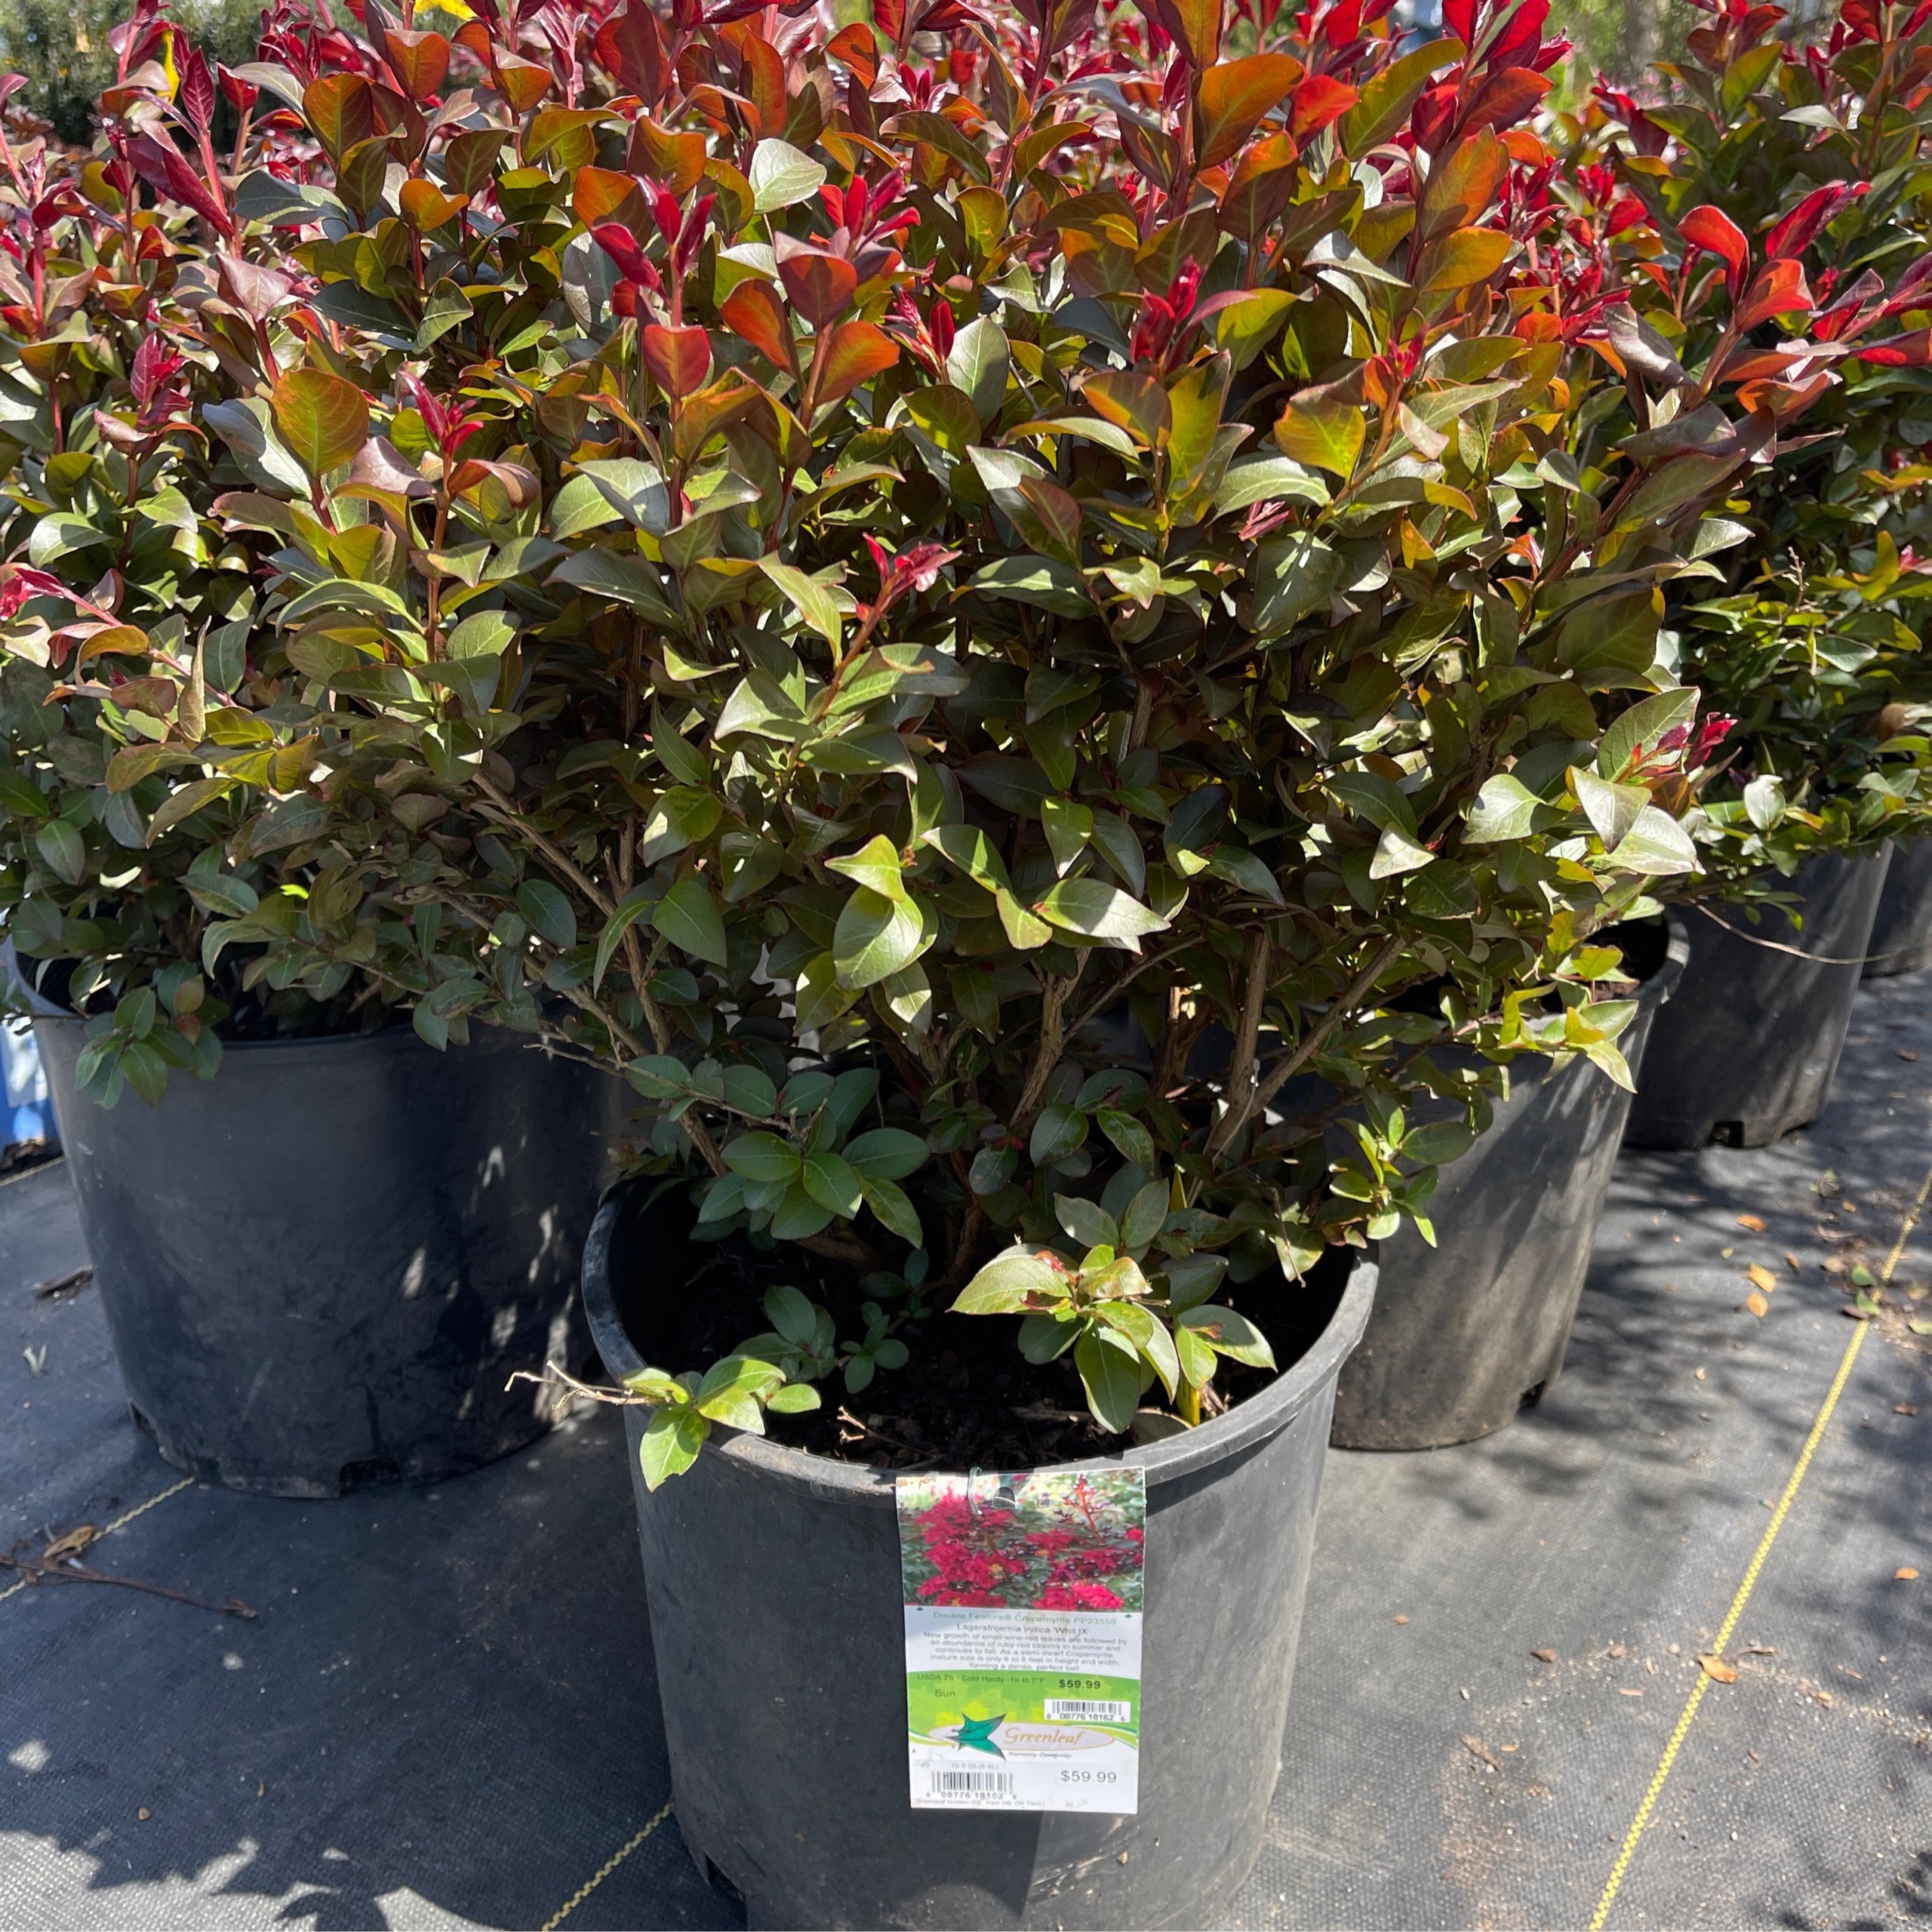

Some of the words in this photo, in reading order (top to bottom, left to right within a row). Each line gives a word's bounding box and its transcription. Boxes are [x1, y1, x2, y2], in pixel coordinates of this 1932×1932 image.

[933, 1611, 966, 1620] Double
[1014, 1614, 1071, 1625] Crapemyrtle
[943, 1632, 971, 1641] growth
[969, 1663, 998, 1671] forming
[981, 1675, 1005, 1684] Hardy
[1058, 1678, 1101, 1690] $59.99
[934, 1688, 955, 1697] Sun
[1003, 1727, 1085, 1746] Greenleaf
[1060, 1770, 1117, 1783] $59.99
